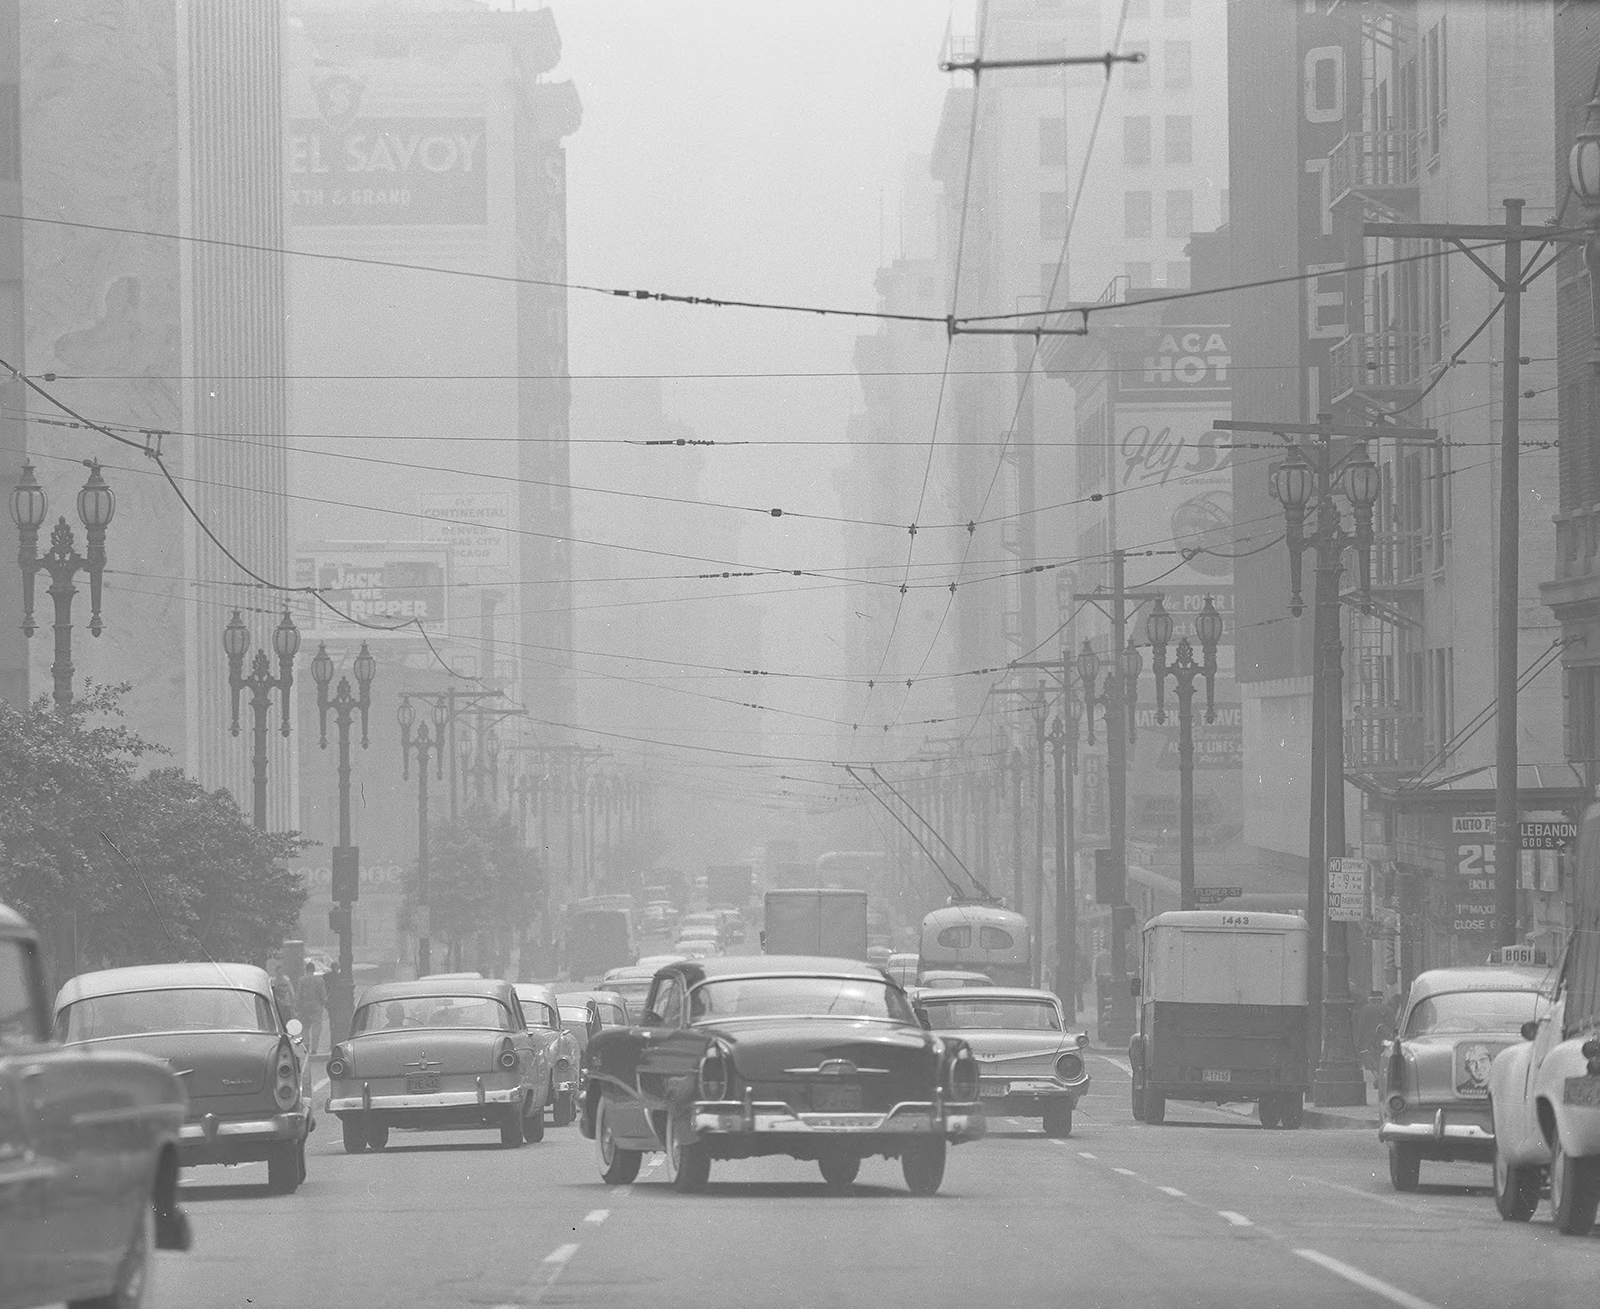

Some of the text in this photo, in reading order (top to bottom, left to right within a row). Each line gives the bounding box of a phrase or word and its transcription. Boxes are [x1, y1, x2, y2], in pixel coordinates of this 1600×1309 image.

[346, 134, 480, 172] SAVOY
[352, 190, 412, 206] GRAND
[1157, 333, 1230, 352] ACA
[1143, 356, 1231, 382] HOT
[1120, 425, 1184, 487] Fly
[424, 508, 507, 518] CONTINENTAL
[441, 527, 487, 535] DENVER
[476, 538, 502, 546] CITY
[331, 567, 383, 590] JACK
[352, 589, 383, 599] THE
[350, 600, 428, 620] RIPPER
[1206, 741, 1234, 753] LINES
[1087, 757, 1099, 831] HOTEL
[1455, 818, 1482, 831] AUTO
[1520, 824, 1577, 837] LEBANON
[1522, 837, 1554, 848] 600 S.
[1330, 859, 1364, 871] NO STOPPING
[1195, 888, 1241, 897] FLOWER ST
[1329, 894, 1363, 906] NO PARKING
[1222, 916, 1249, 925] 1443
[1454, 920, 1486, 931] CLOSE
[1506, 950, 1531, 962] 8061
